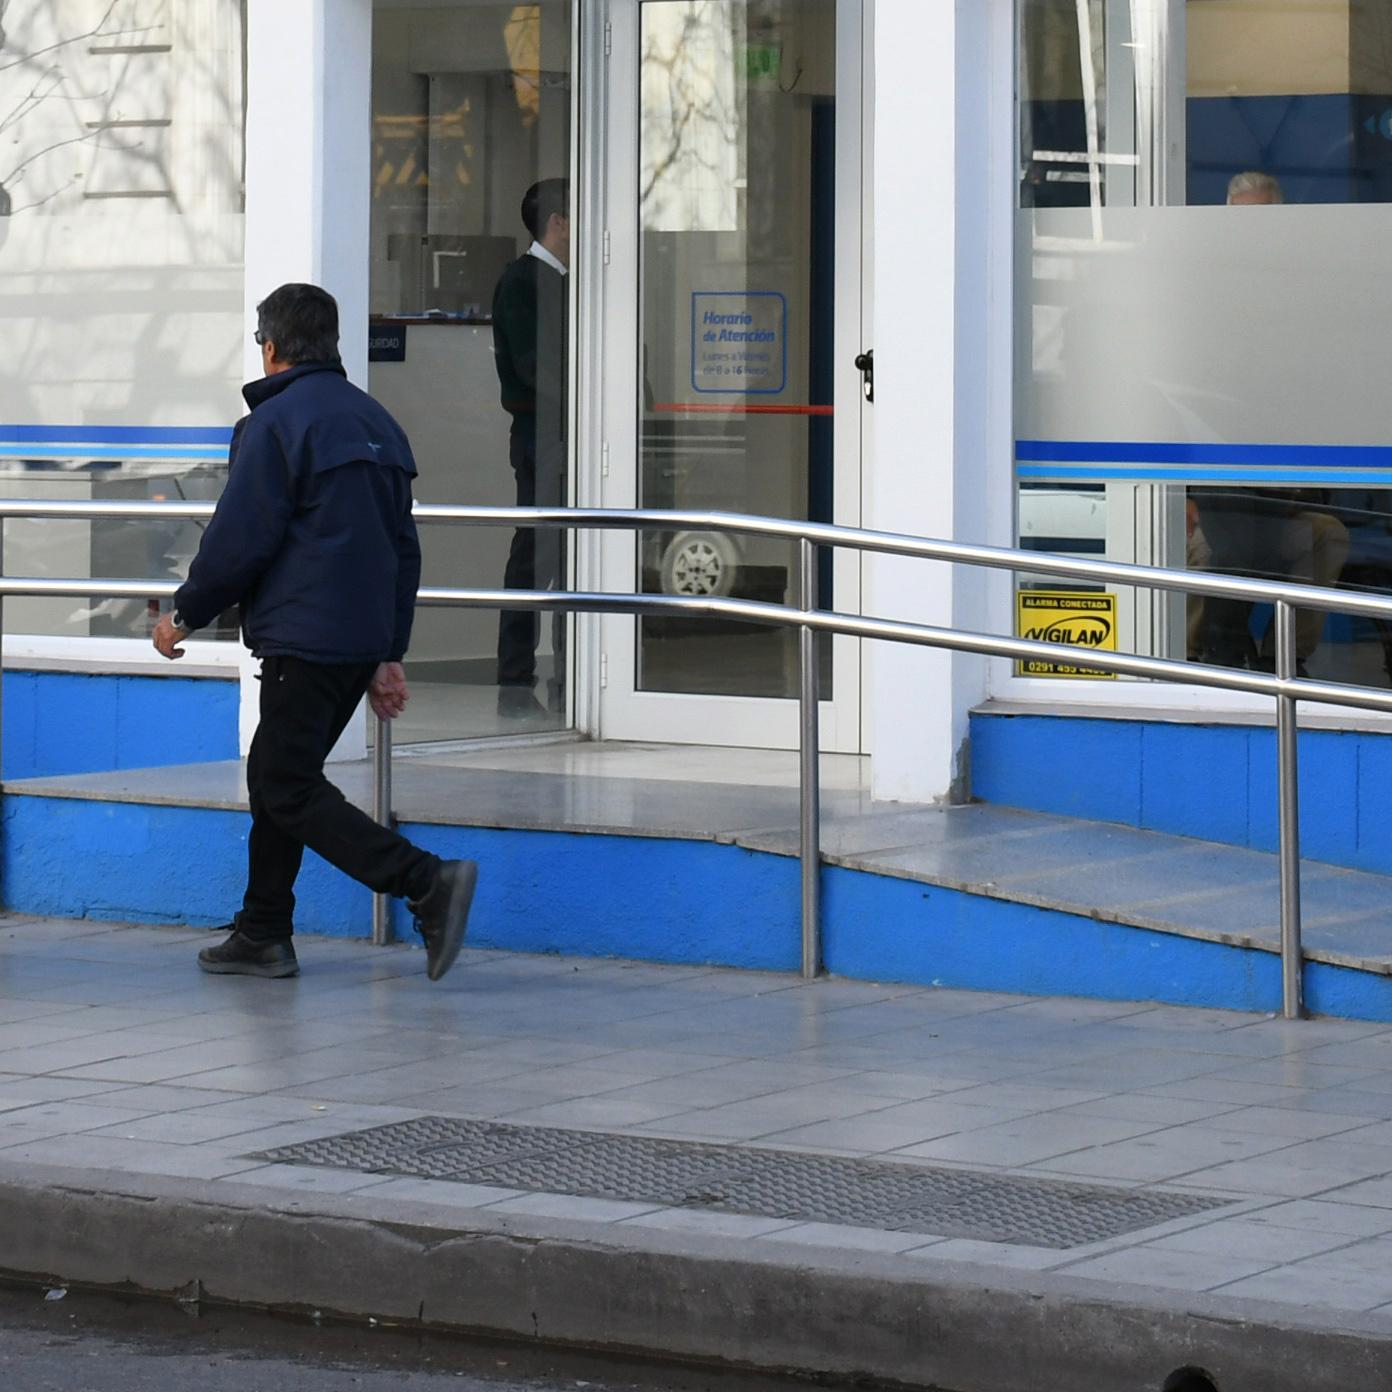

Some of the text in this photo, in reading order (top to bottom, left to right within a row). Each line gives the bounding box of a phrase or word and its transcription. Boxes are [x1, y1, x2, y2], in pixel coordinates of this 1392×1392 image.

[703, 311, 753, 325] Horario
[703, 328, 776, 343] de Atención
[1025, 598, 1108, 609] ALARMA CONECTADA
